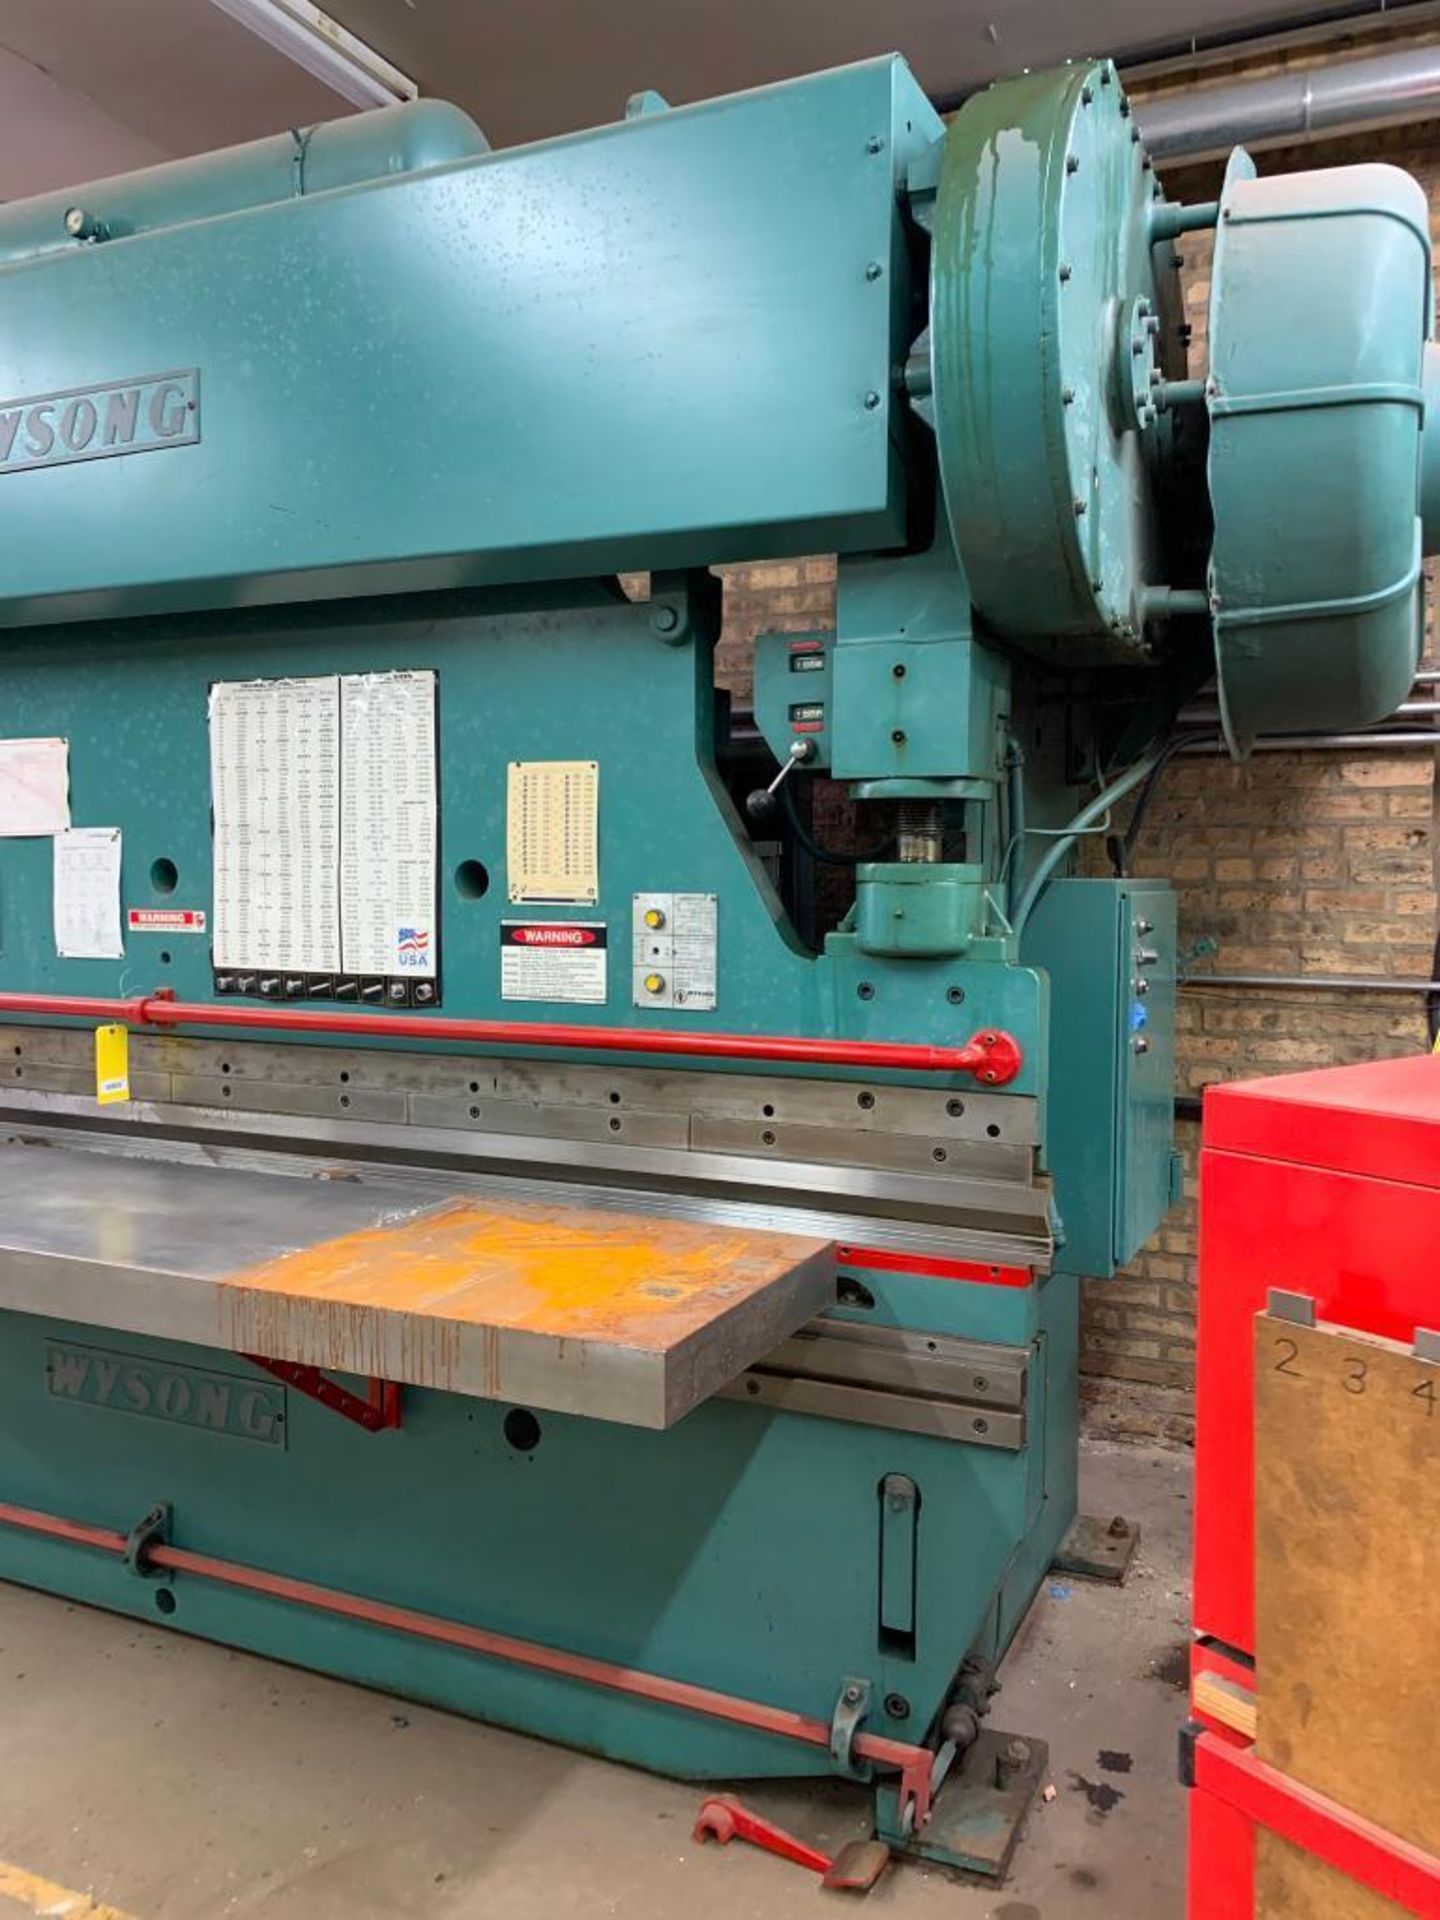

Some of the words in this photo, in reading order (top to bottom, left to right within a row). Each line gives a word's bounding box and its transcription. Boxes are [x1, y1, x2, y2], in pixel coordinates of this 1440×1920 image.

[524, 929, 583, 944] WARNING
[398, 954, 428, 967] USA
[51, 1352, 274, 1436] WYSONG
[1274, 1338, 1304, 1378] 2
[1342, 1357, 1367, 1394] 3
[1411, 1380, 1438, 1417] 4
